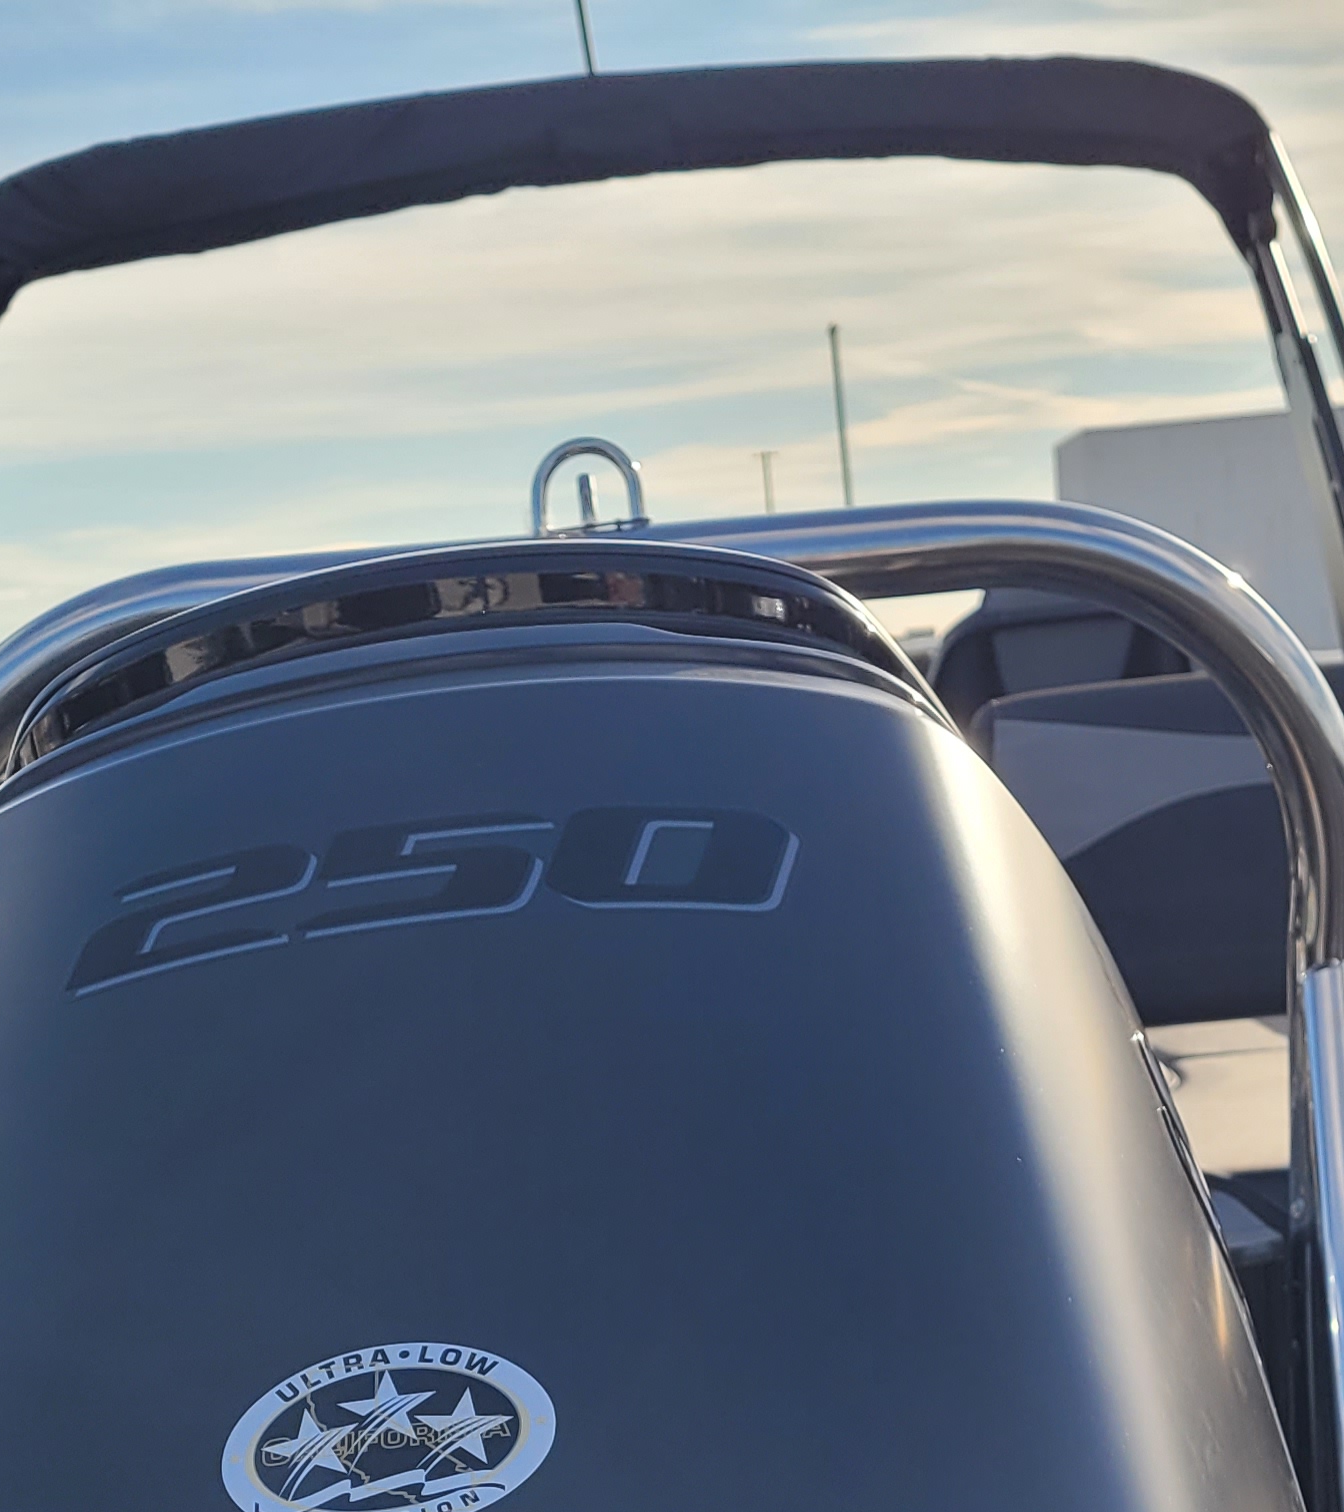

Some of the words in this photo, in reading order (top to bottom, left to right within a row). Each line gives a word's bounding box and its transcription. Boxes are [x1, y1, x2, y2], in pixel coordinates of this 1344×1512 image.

[65, 805, 801, 998] 250
[274, 1347, 391, 1404] ULTRA
[417, 1344, 500, 1376] LOW
